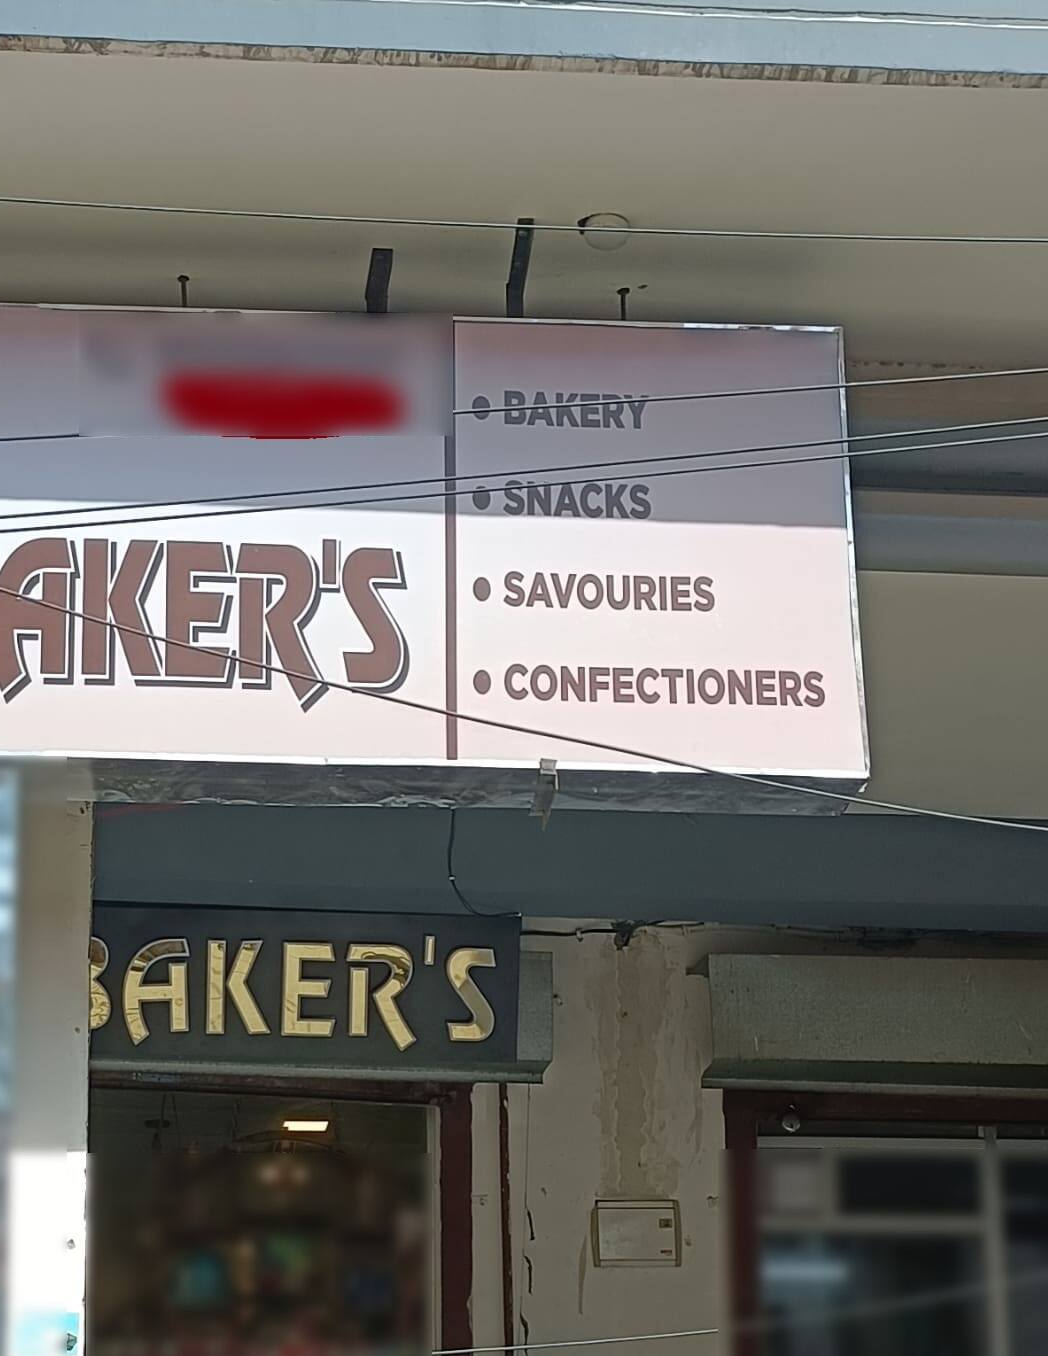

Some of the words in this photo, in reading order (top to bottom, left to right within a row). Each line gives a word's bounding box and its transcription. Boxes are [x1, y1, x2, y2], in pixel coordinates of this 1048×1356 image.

[503, 389, 649, 430] BAKERY
[503, 480, 652, 520] SNACKS
[503, 571, 716, 612] SAVOURIES
[504, 663, 826, 708] CONFECTIONERS
